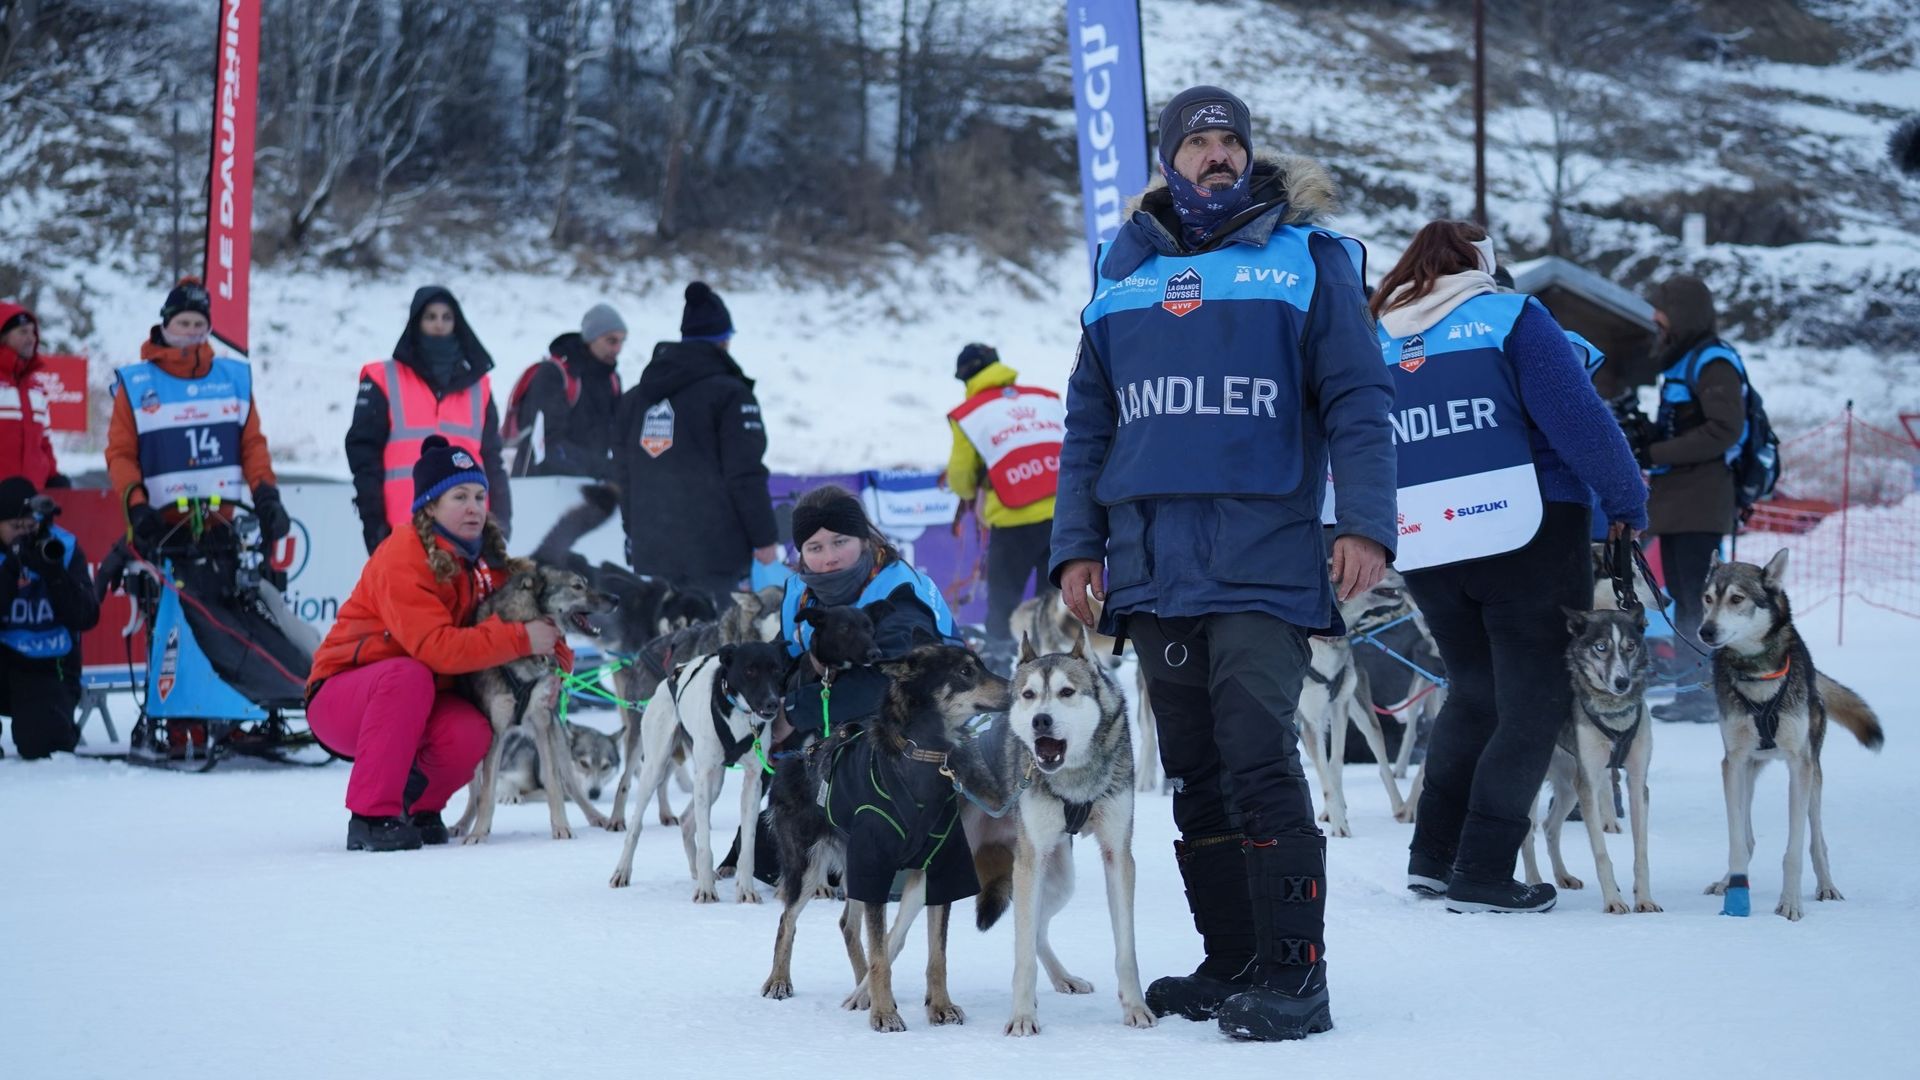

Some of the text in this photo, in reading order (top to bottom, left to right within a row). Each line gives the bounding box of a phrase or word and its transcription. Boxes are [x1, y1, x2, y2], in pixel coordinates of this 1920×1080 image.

[220, 0, 241, 229] DAUPHIN
[220, 234, 233, 300] LE
[1254, 268, 1300, 288] VVF
[1166, 290, 1200, 299] ODYSSÉE
[1176, 283, 1200, 291] GRANDE
[1387, 397, 1499, 446] NDLER
[185, 427, 220, 459] 14
[1006, 458, 1044, 485] DOG
[1457, 500, 1508, 517] SUZUKI
[1401, 523, 1422, 535] CANIN
[3, 598, 54, 623] DIA
[284, 590, 337, 621] ion
